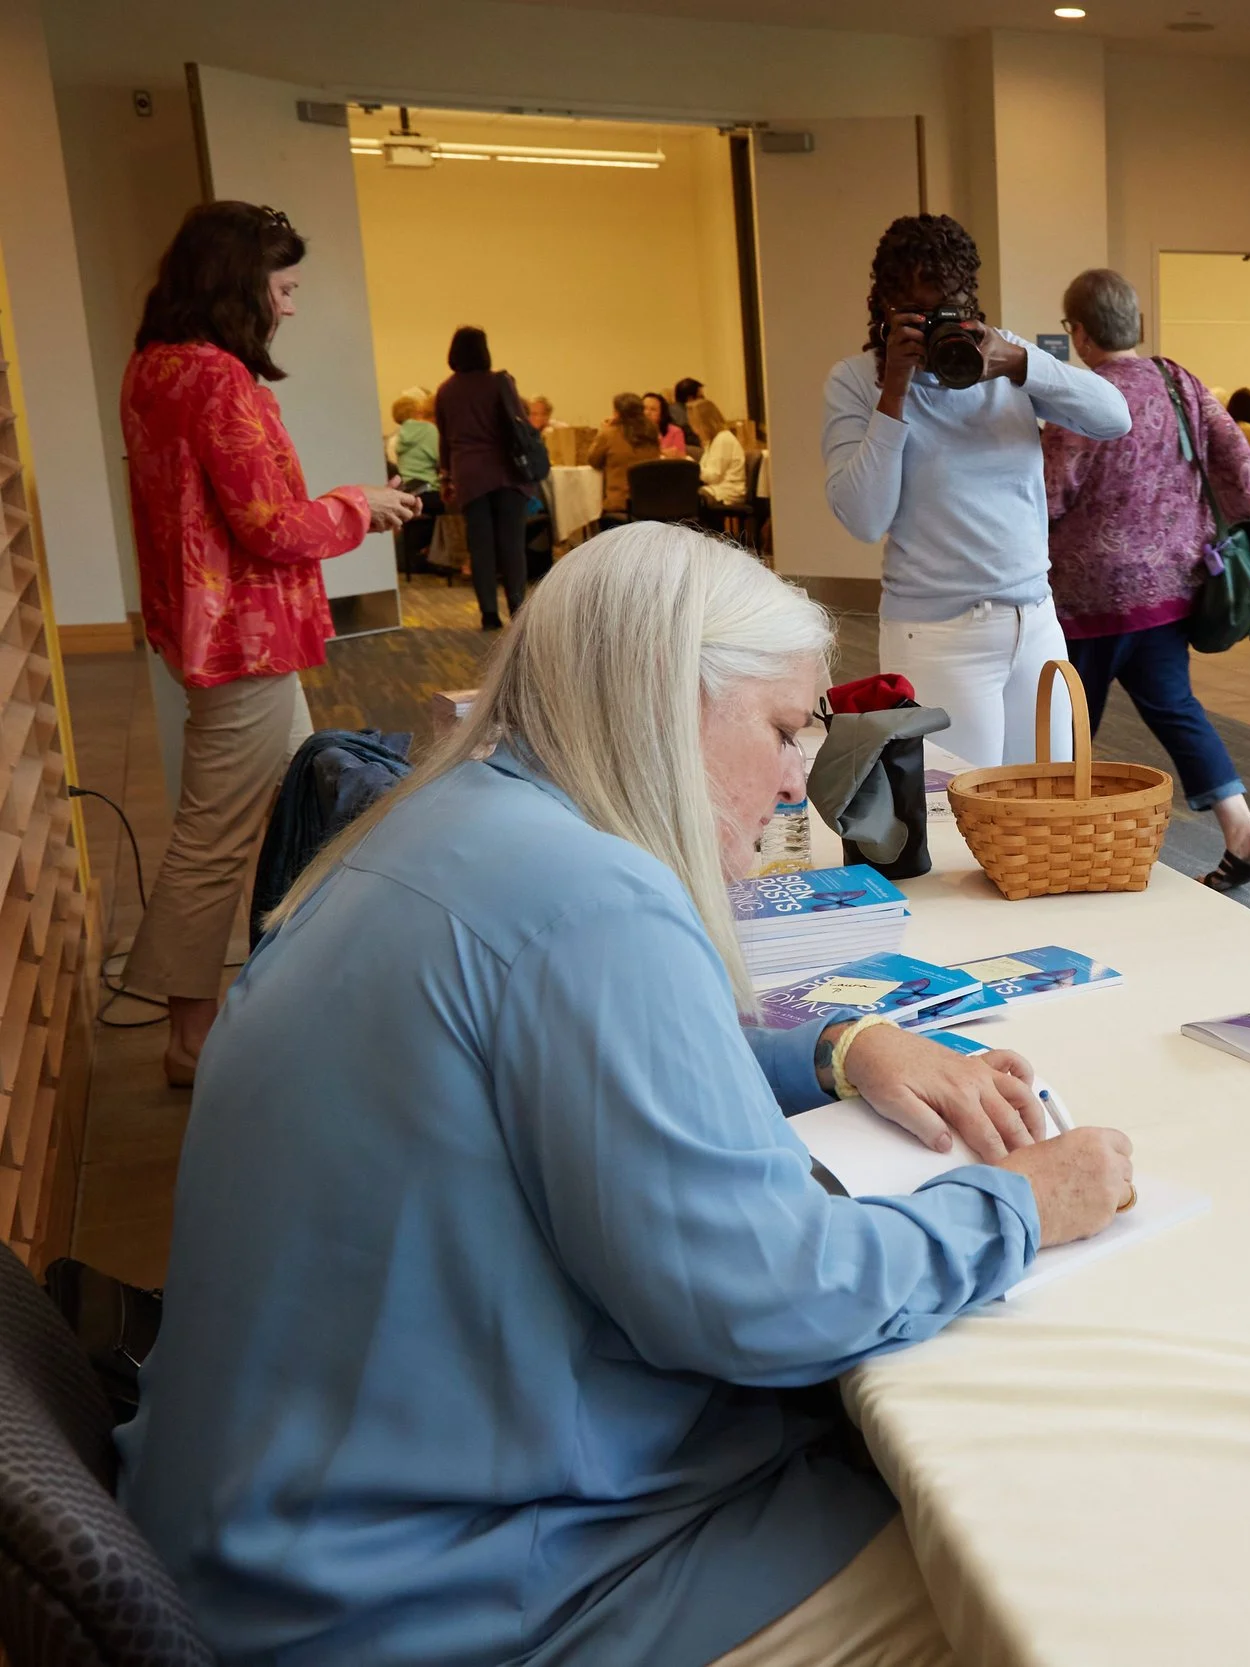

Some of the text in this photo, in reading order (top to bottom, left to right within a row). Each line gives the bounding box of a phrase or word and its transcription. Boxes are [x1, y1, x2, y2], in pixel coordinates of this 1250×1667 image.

[727, 885, 765, 911] YING
[750, 878, 802, 912] POSTS
[776, 875, 815, 899] SIGN
